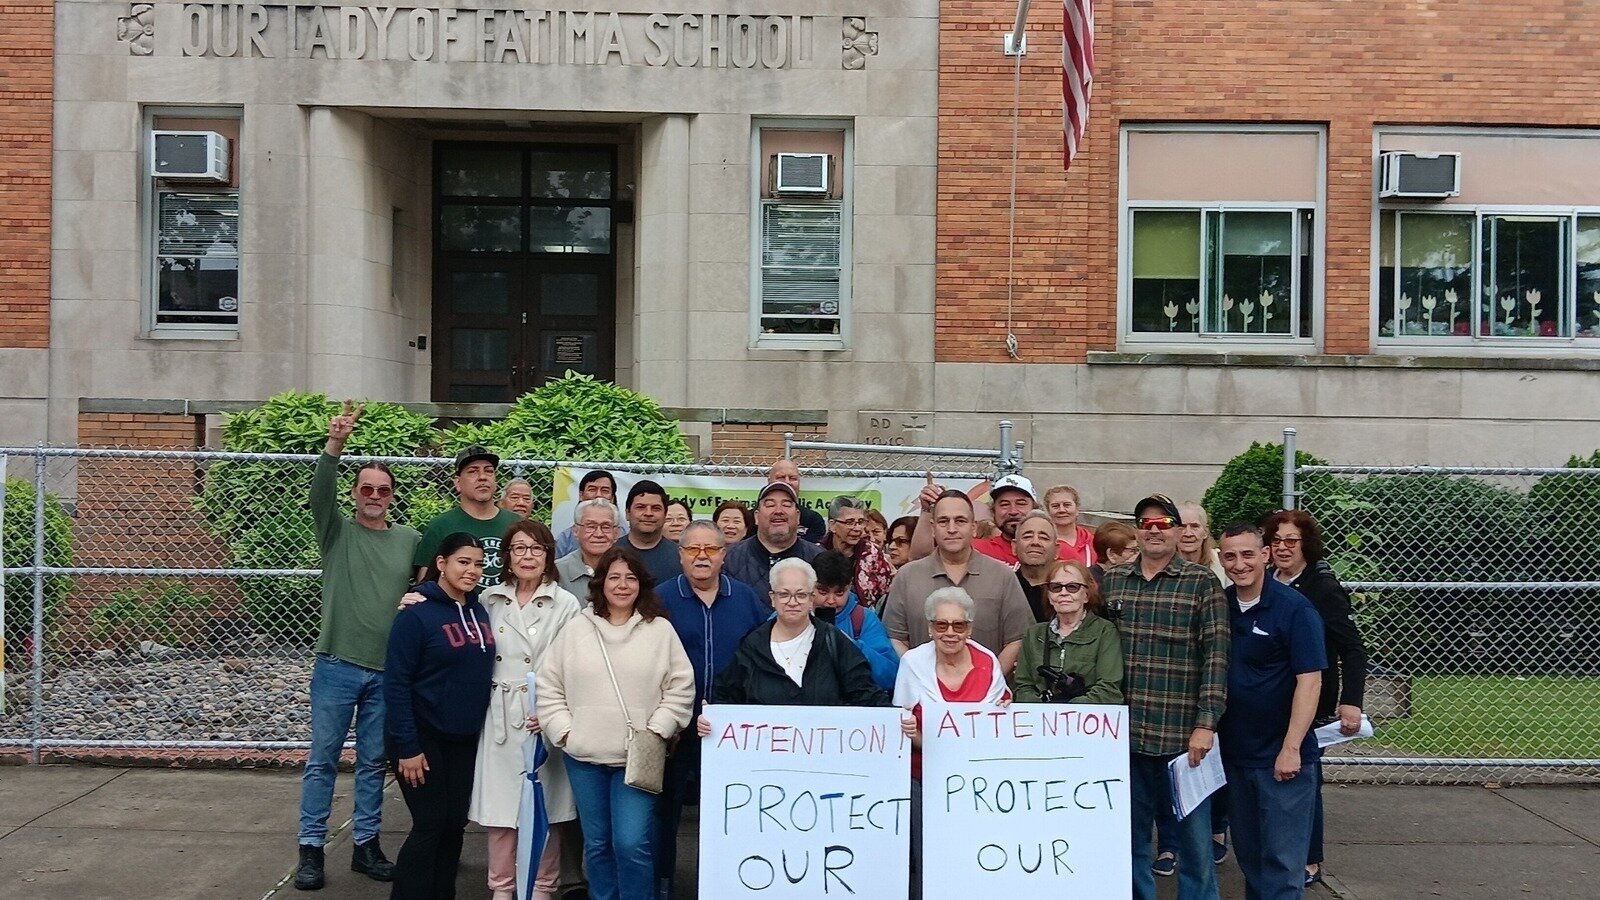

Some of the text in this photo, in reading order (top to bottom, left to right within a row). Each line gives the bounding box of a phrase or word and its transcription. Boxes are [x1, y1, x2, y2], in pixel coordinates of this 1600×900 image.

[183, 4, 814, 69] OUR LADY OF FATIMA SCHOOL
[699, 496, 713, 507] of
[937, 710, 1121, 739] ATTENTION
[723, 783, 911, 835] PROTECT
[946, 774, 1124, 814] PROTECT
[738, 845, 855, 894] OUR
[977, 839, 1073, 875] OUR
